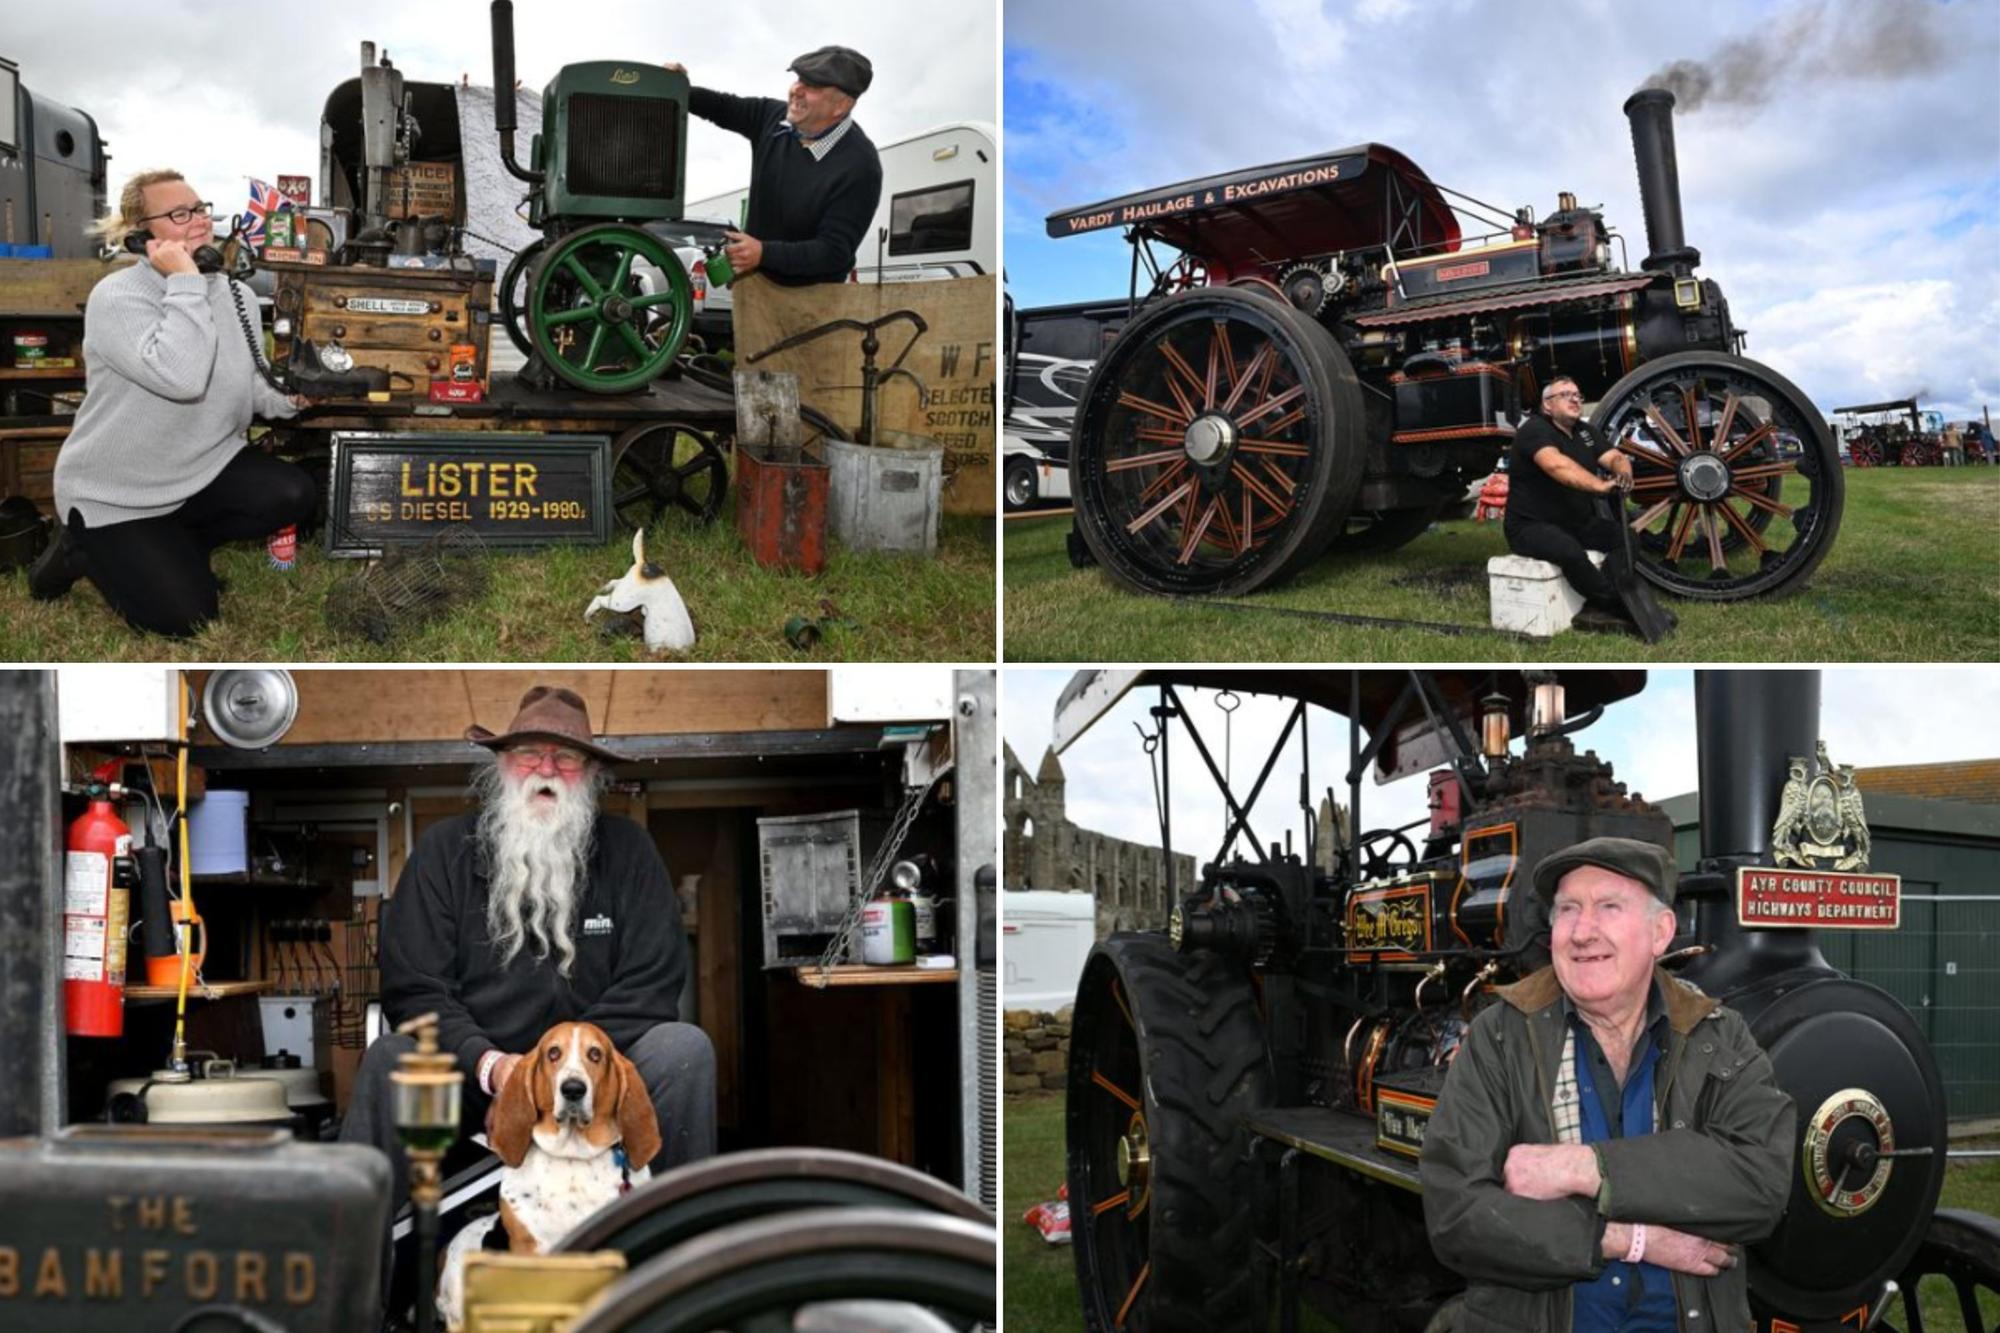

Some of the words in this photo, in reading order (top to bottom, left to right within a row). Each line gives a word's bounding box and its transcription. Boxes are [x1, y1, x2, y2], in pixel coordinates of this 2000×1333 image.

[1068, 211, 1114, 231] VARDY
[1122, 195, 1194, 221] HAULAGE
[1204, 191, 1214, 204] &
[1225, 165, 1339, 200] EXCAVATIONS
[350, 300, 387, 311] SHELL
[940, 344, 961, 378] W
[973, 342, 992, 378] F
[926, 410, 990, 427] SCOTCH
[401, 462, 538, 497] LISTER
[401, 502, 473, 521] DIESEL
[1750, 877, 1777, 892] AYR
[1782, 879, 1833, 894] COUNTY
[1748, 901, 1812, 916] HIGHWAYS
[1818, 904, 1893, 919] DEPARTMENT
[108, 1194, 197, 1234] THE
[0, 1247, 316, 1304] BAMFORD
